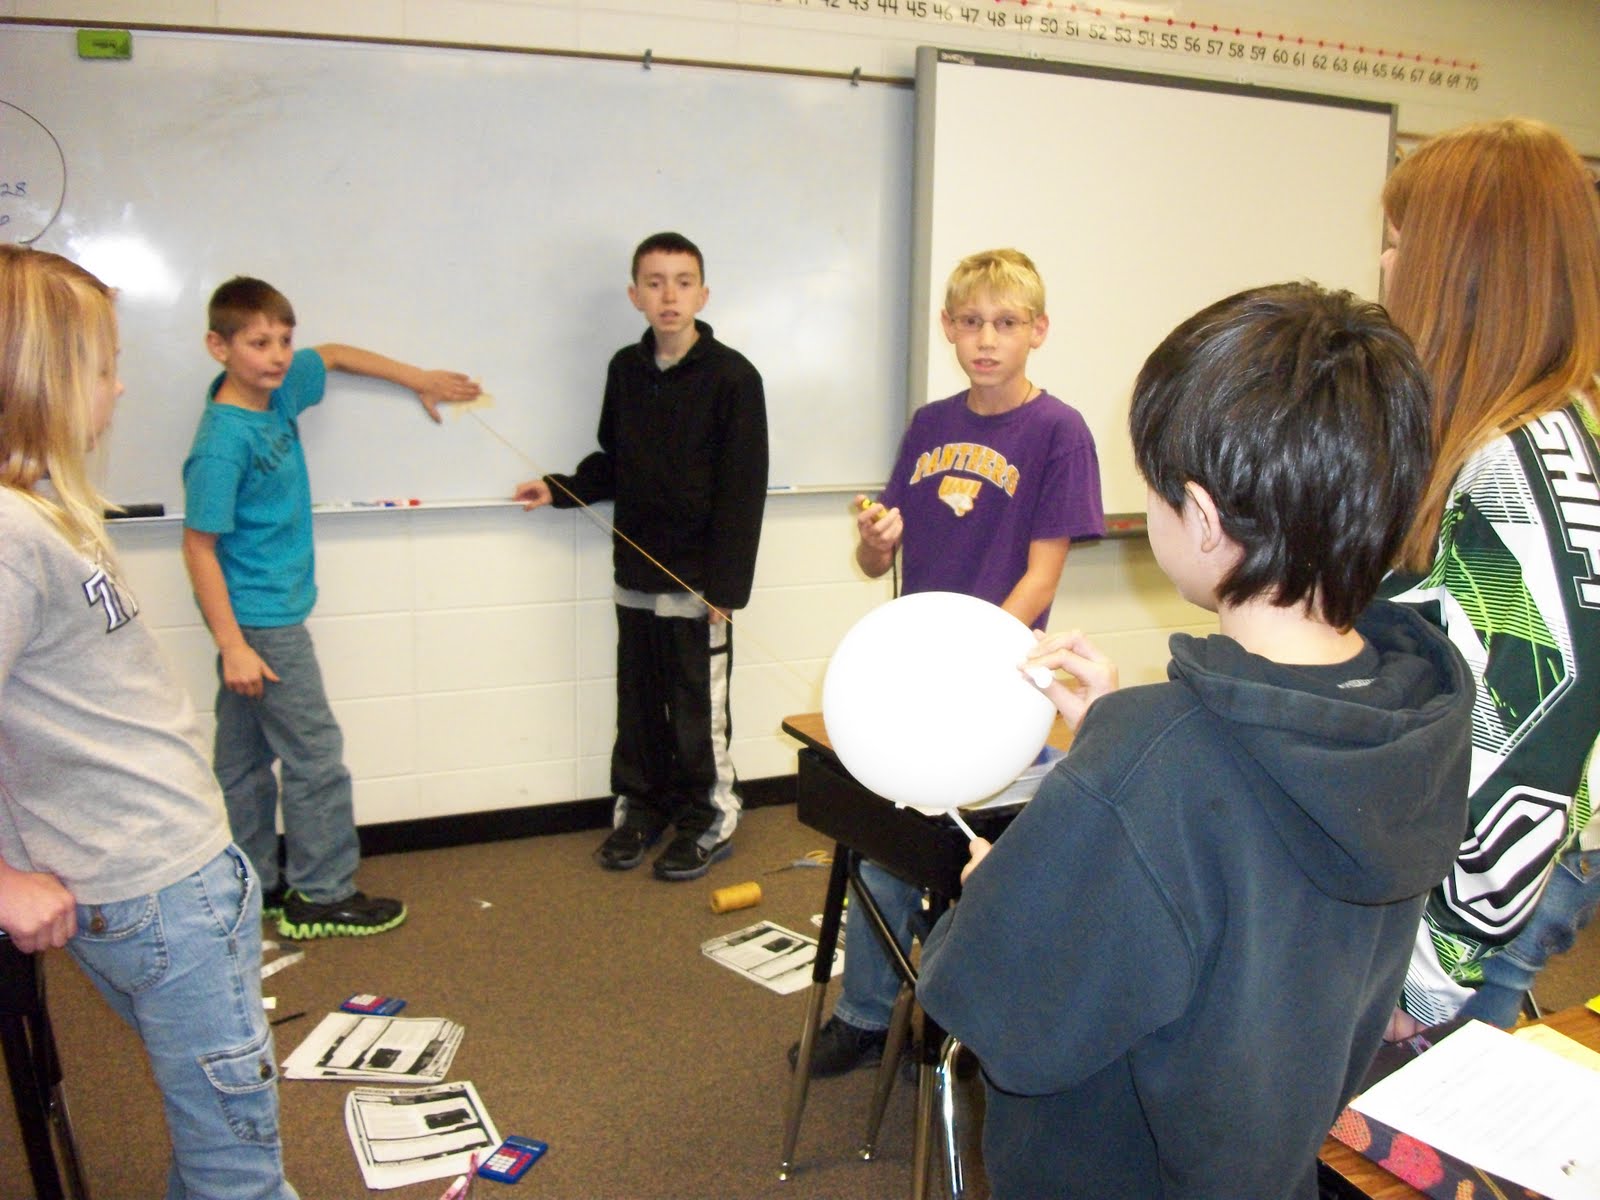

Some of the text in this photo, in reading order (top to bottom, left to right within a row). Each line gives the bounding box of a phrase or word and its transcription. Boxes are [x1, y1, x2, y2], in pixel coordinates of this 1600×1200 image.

[848, 0, 870, 11] 43
[877, 0, 898, 14] 44
[906, 1, 927, 18] 45
[932, 3, 954, 21] 46
[960, 7, 981, 24] 47
[986, 10, 1007, 27] 48
[1014, 13, 1033, 31] 49
[1040, 17, 1059, 34] 50
[1065, 21, 1080, 37] 51
[1088, 24, 1108, 41] 52
[1114, 26, 1132, 44] 53
[1137, 29, 1155, 47] 54
[1160, 33, 1178, 50] 55
[1184, 36, 1201, 53] 56
[1207, 40, 1224, 56] 57
[1228, 42, 1245, 59] 58
[1249, 45, 1267, 62] 59
[1272, 48, 1289, 65] 60
[1292, 52, 1306, 67] 61
[1312, 54, 1328, 71] 62
[1333, 57, 1348, 73] 63
[1353, 60, 1369, 75] 64
[1372, 64, 1388, 79] 65
[1390, 66, 1406, 82] 66
[1409, 69, 1425, 84] 67
[1428, 71, 1443, 86] 68
[1446, 74, 1461, 89] 69
[1465, 76, 1479, 92] 70
[909, 442, 1020, 498] PANTHERS
